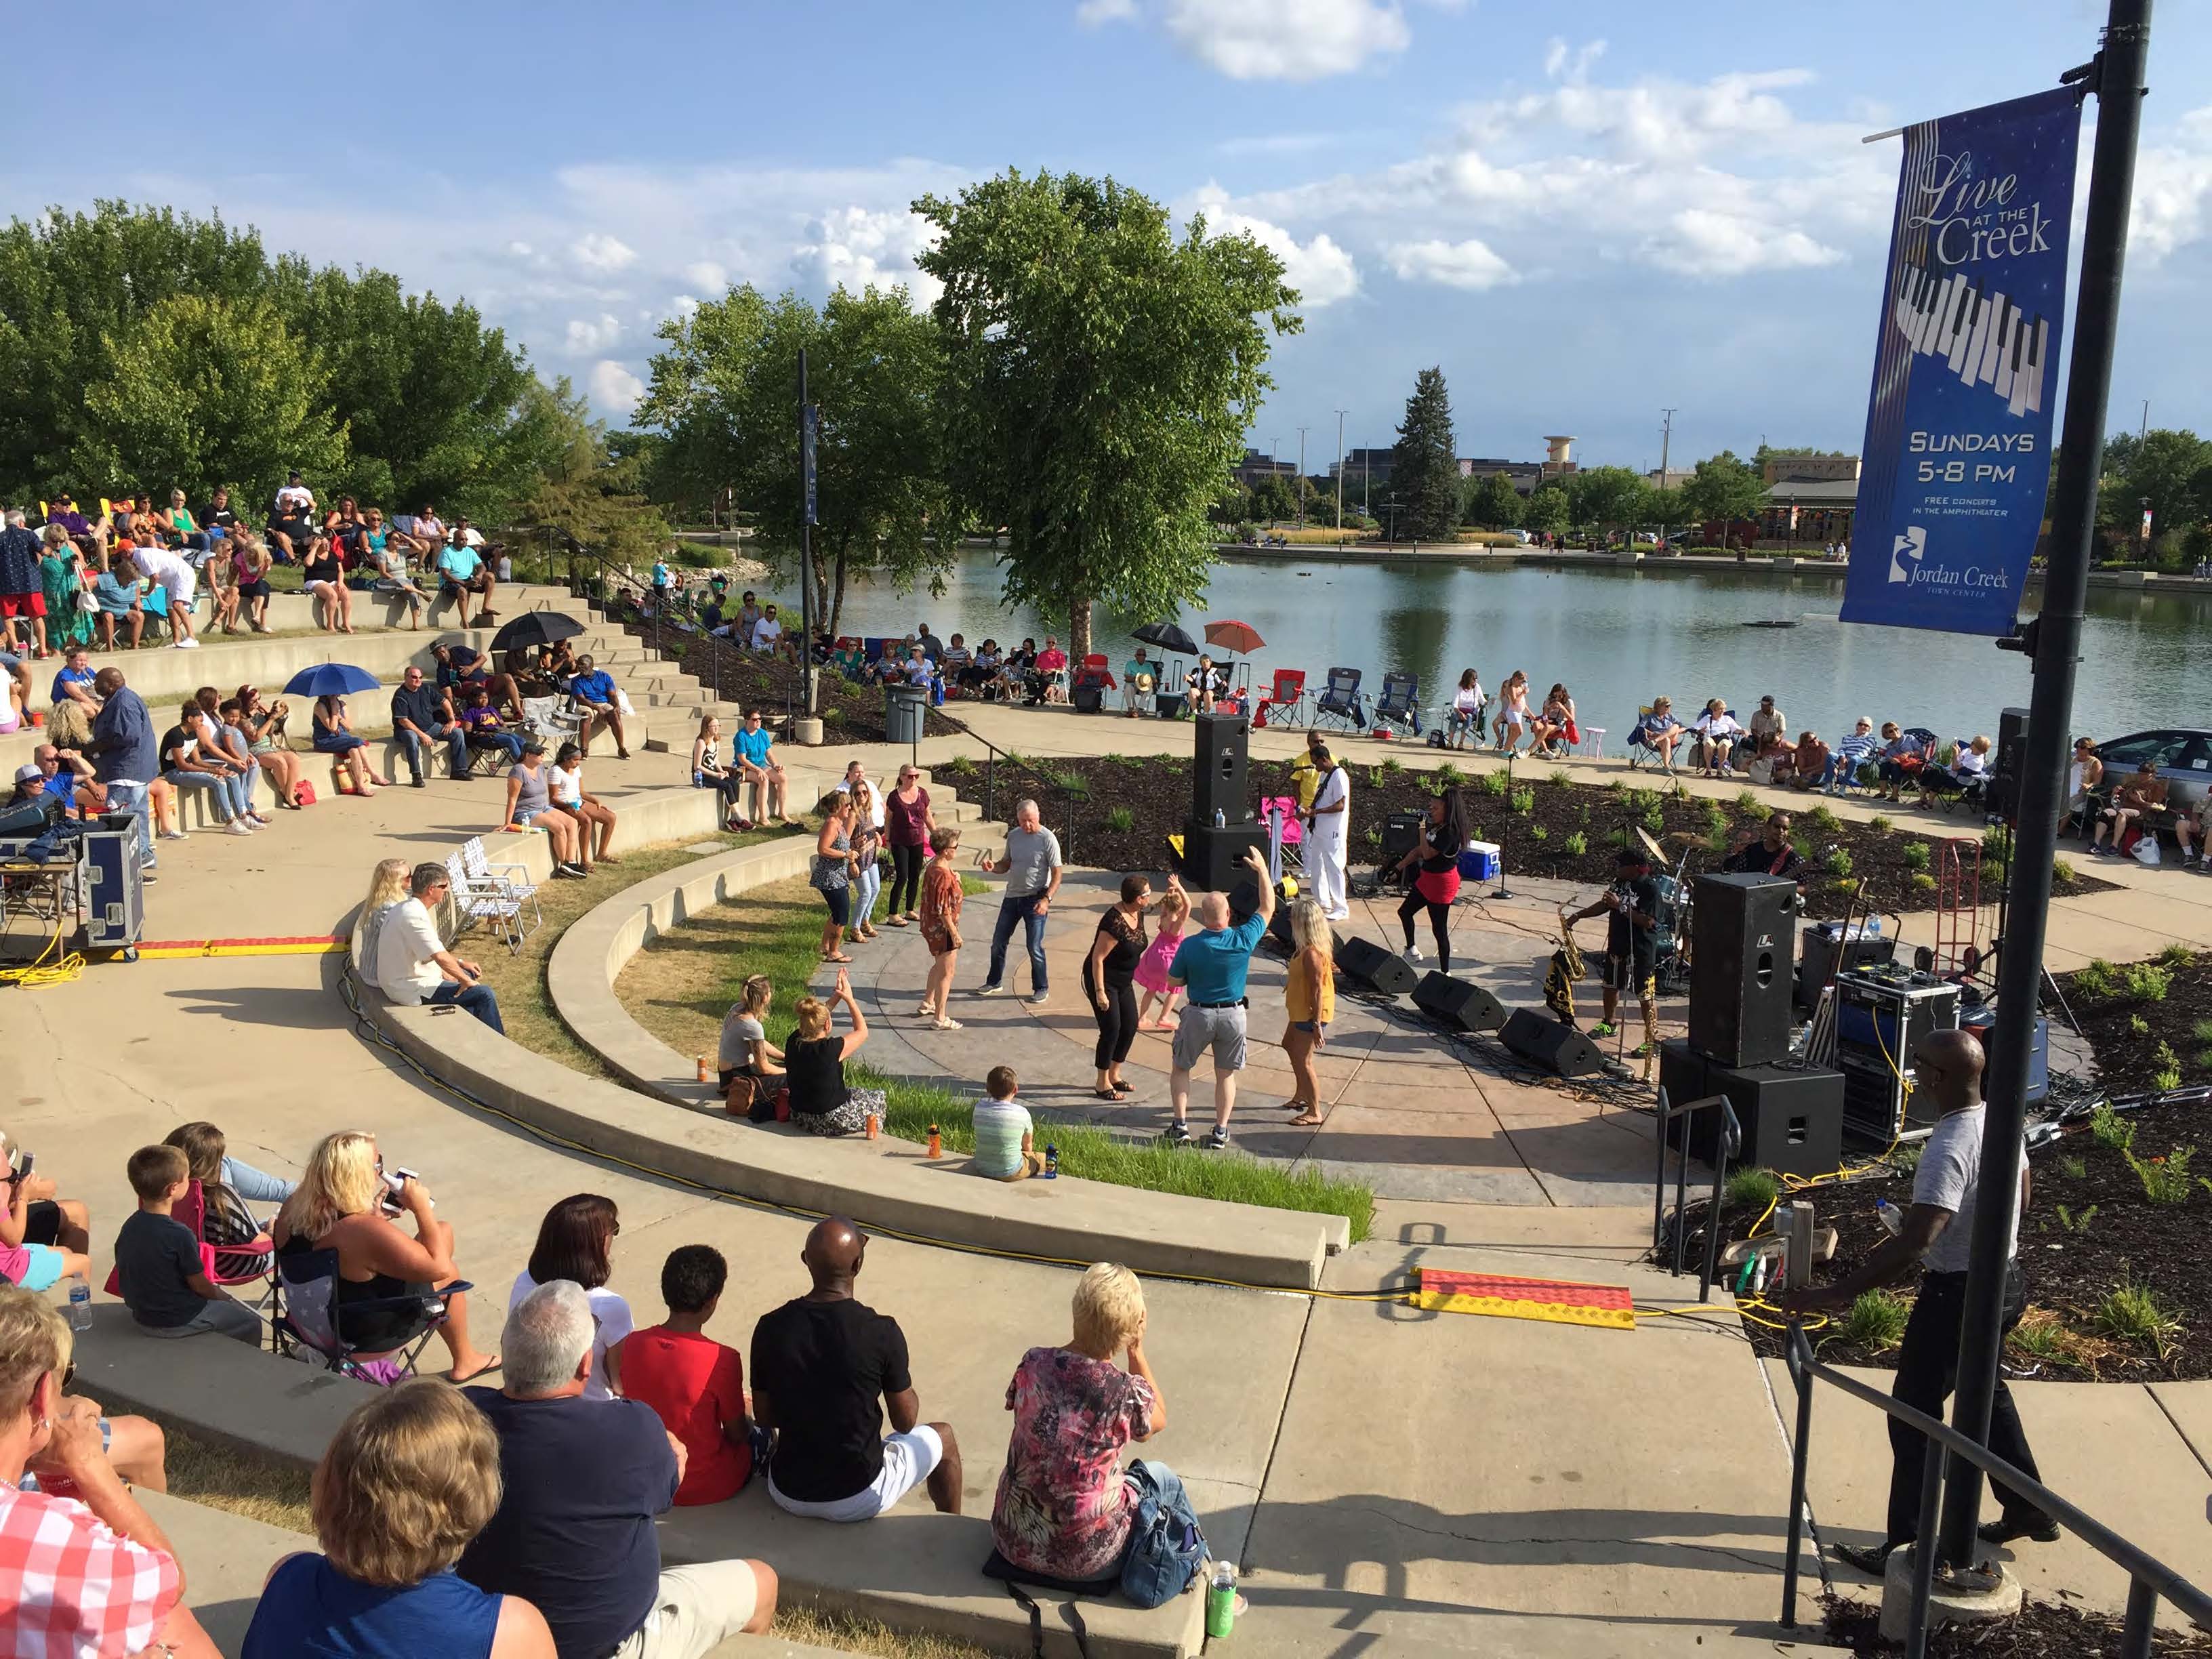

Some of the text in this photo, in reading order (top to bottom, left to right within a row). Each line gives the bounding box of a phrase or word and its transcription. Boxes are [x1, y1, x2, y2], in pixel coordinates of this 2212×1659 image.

[1908, 151, 2017, 229] Live
[1973, 207, 2028, 226] AT THE
[1937, 201, 2051, 266] Creek
[1909, 431, 2034, 453] SUNDAYS
[1918, 461, 2016, 483] 5-8 PM
[1924, 496, 1950, 505] FREE
[1942, 508, 2009, 517] AMPHITHEATER
[1907, 563, 2008, 588] Jordan Creek
[1927, 587, 1986, 598] TOWN CENTER
